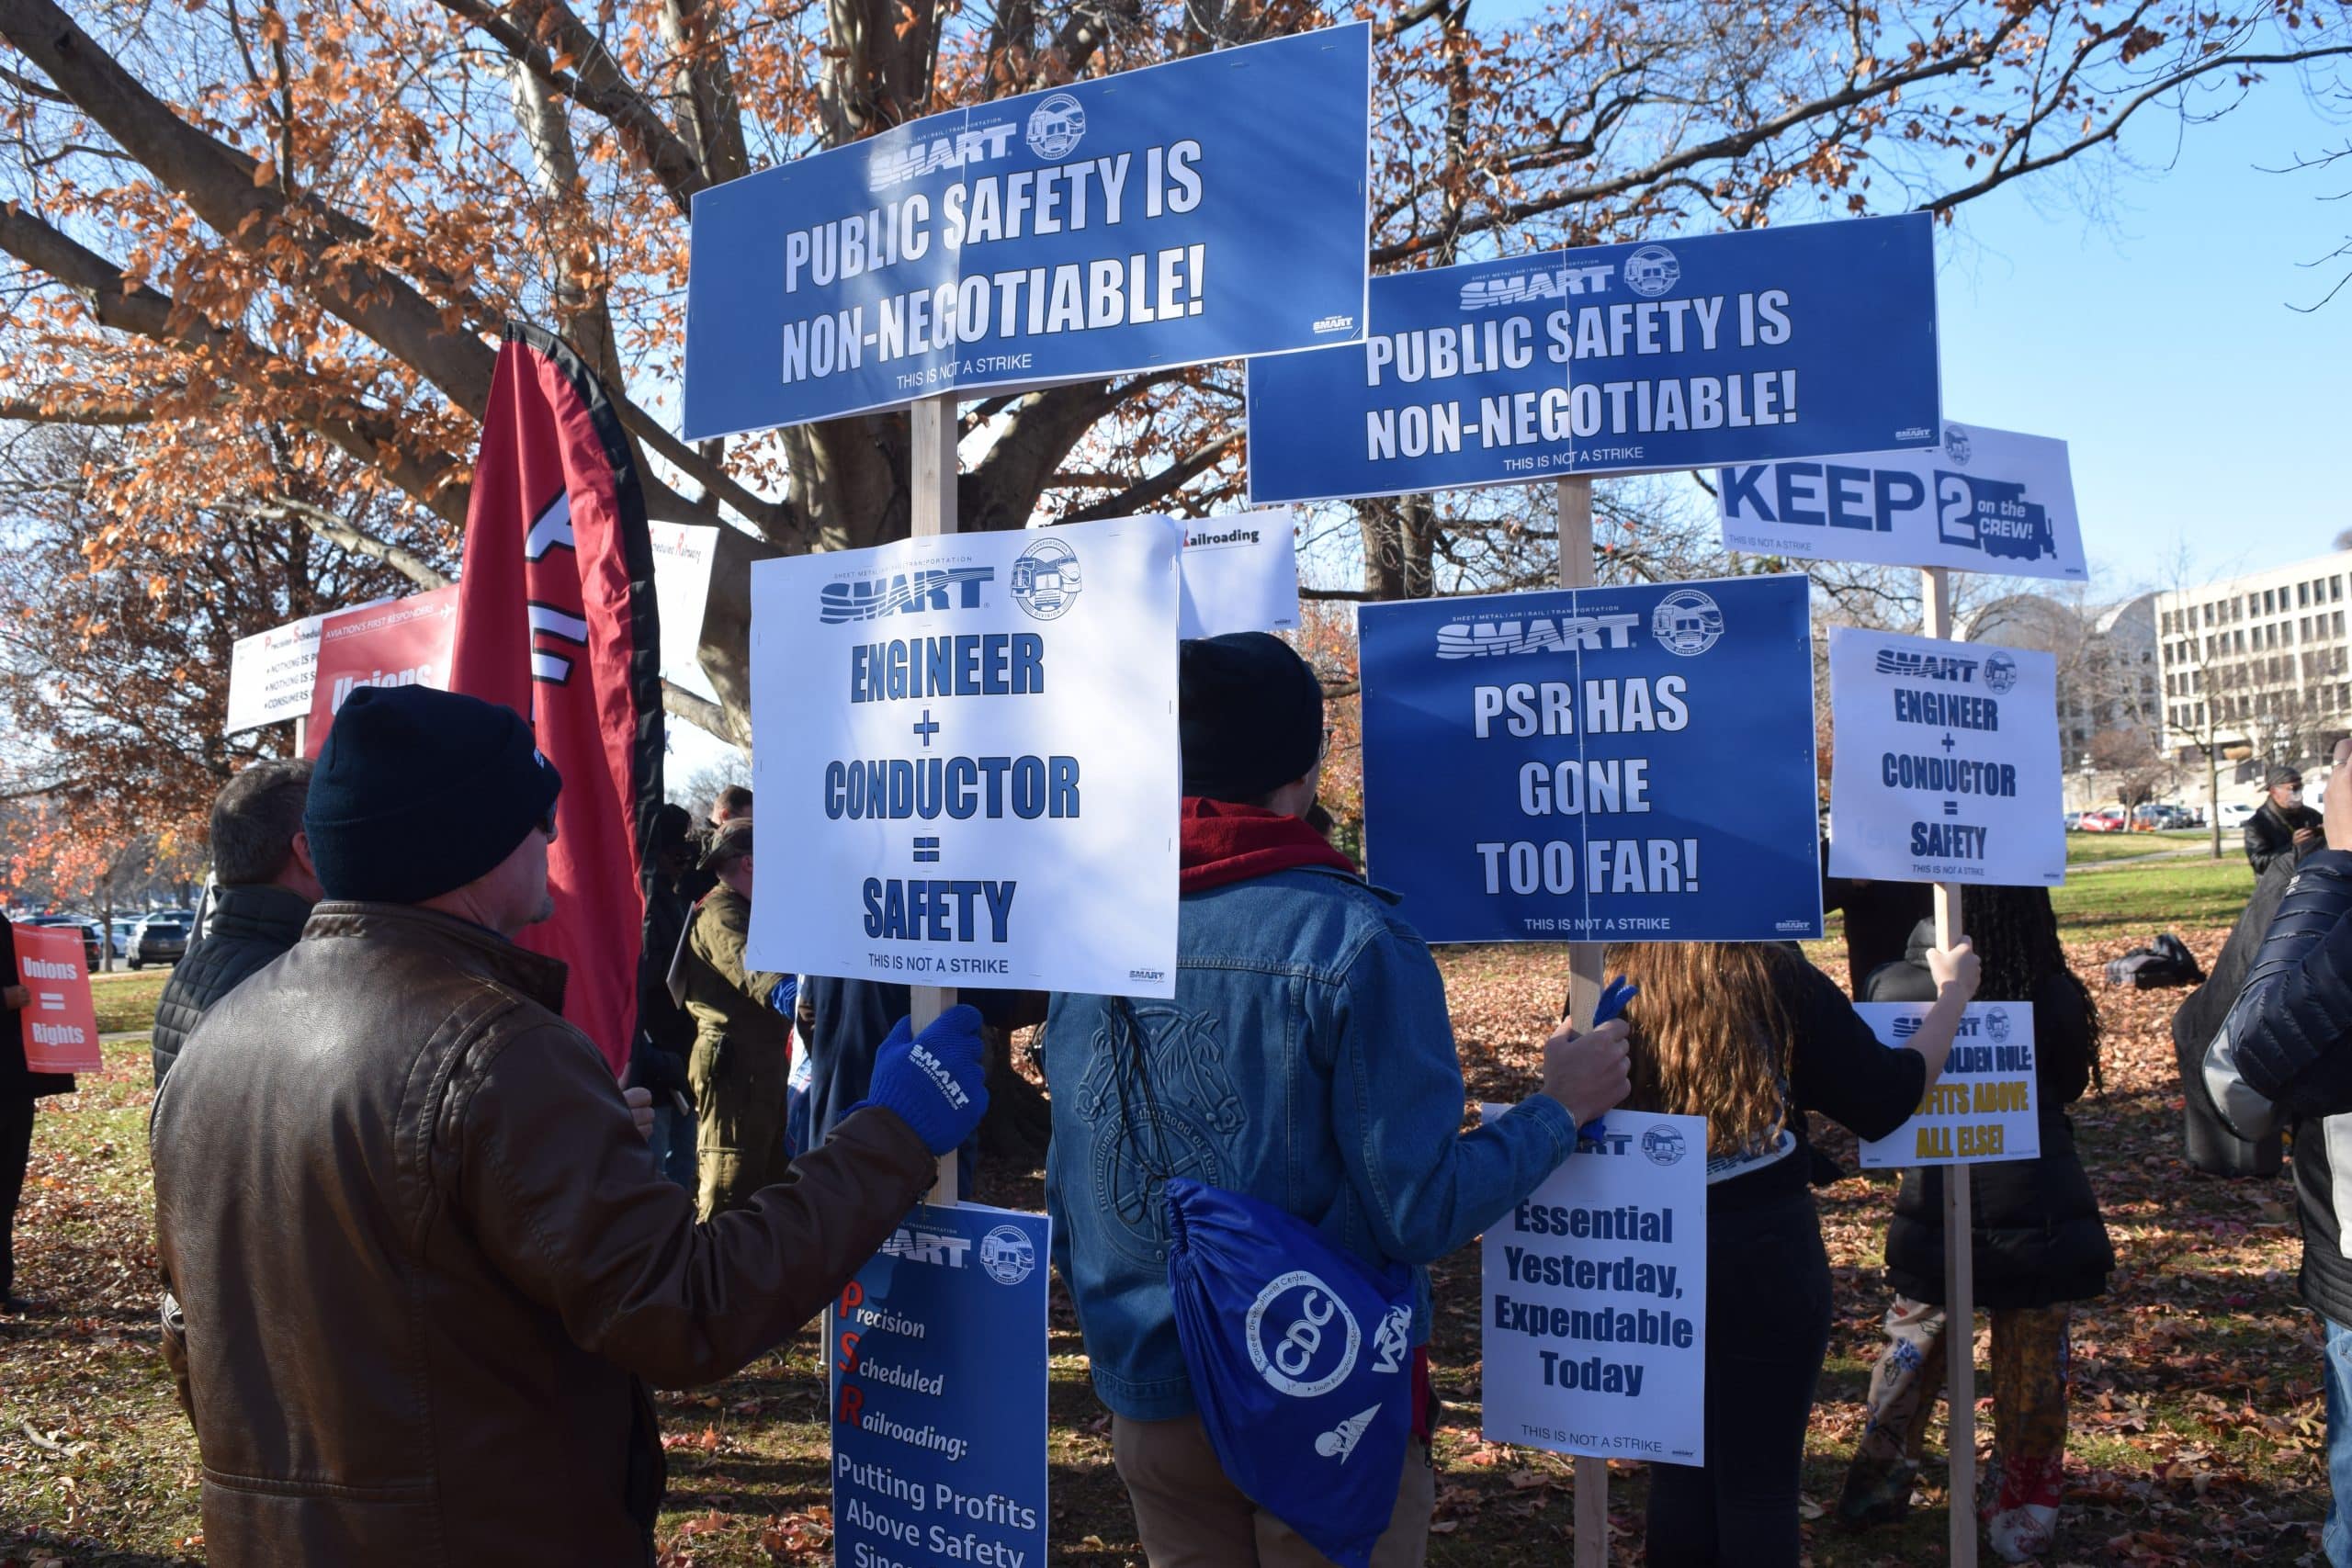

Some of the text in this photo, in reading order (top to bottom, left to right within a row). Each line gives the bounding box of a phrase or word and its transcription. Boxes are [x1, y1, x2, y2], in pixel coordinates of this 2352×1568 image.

[869, 122, 1017, 192] SMART
[786, 139, 1204, 293] PUBLIC SAFETY IS
[1459, 265, 1615, 311] SMART
[781, 243, 1206, 384] NON-NEGOTIABLE!
[1366, 288, 1792, 388] PUBLIC SAFETY IS
[897, 353, 1033, 390] THIS IS NOT A STRIKE
[1365, 369, 1799, 463] NON-NEGOTIABLE!
[1503, 446, 1645, 471] THIS IS NOT A STRIKE
[1721, 462, 1975, 540] KEEP 2
[1977, 499, 2026, 519] on the
[1728, 535, 1747, 545] THIS
[1758, 537, 1774, 548] NOT
[1776, 540, 1782, 549] A
[1783, 539, 1813, 552] STRIKE
[1979, 516, 2034, 541] CREW!
[368, 617, 387, 629] FIRST
[387, 605, 435, 625] RESPONDERS
[820, 566, 995, 625] SMART
[1552, 605, 1620, 615] TRANPORTATION
[1436, 613, 1639, 660] SMART
[300, 672, 308, 682] IS
[301, 655, 309, 665] IS
[851, 632, 1045, 704] ENGINEER
[1875, 649, 1978, 682] SMART
[1474, 675, 1689, 739] PSR HAS
[1894, 688, 1998, 732] ENGINEER
[825, 755, 1080, 820] CONDUCTOR
[1519, 758, 1651, 816] GONE
[1882, 752, 2016, 797] CONDUCTOR
[1910, 821, 1986, 860] SAFETY
[1476, 838, 1699, 895] TOO FAR!
[1912, 864, 1931, 874] THIS
[1933, 865, 1941, 874] IS
[1942, 866, 1956, 874] NOT
[1958, 866, 1963, 874] A
[862, 876, 1017, 943] SAFETY
[1523, 918, 1671, 931] THIS IS NOT A STRIKE
[22, 955, 78, 980] Unions
[868, 953, 1010, 974] THIS IS NOT A STRIKE
[31, 1021, 85, 1046] Rights
[910, 1043, 969, 1105] SMART
[1941, 1046, 1993, 1074] OLDEN
[1973, 1080, 2030, 1113] ABOVE
[1916, 1123, 2004, 1159] ALL ELSE!
[1095, 1122, 1120, 1213] International
[1514, 1199, 1673, 1244] Essential
[876, 1228, 971, 1269] ART
[1281, 1272, 1307, 1286] Center
[1504, 1246, 1683, 1301] Yesterday,
[839, 1280, 925, 1339] Precision
[1275, 1289, 1335, 1376] CDC
[1495, 1294, 1693, 1349] Expendable
[839, 1331, 944, 1396] Scheduled
[1539, 1350, 1644, 1397] Today
[839, 1383, 968, 1461] Railroading:
[1521, 1424, 1551, 1439] THIS
[1555, 1430, 1566, 1442] IS
[1569, 1433, 1599, 1447] NOT
[1600, 1437, 1611, 1448] A
[1613, 1437, 1662, 1453] STRIKE
[838, 1452, 1036, 1531] Putting Profits
[846, 1498, 1025, 1568] Above Safety
